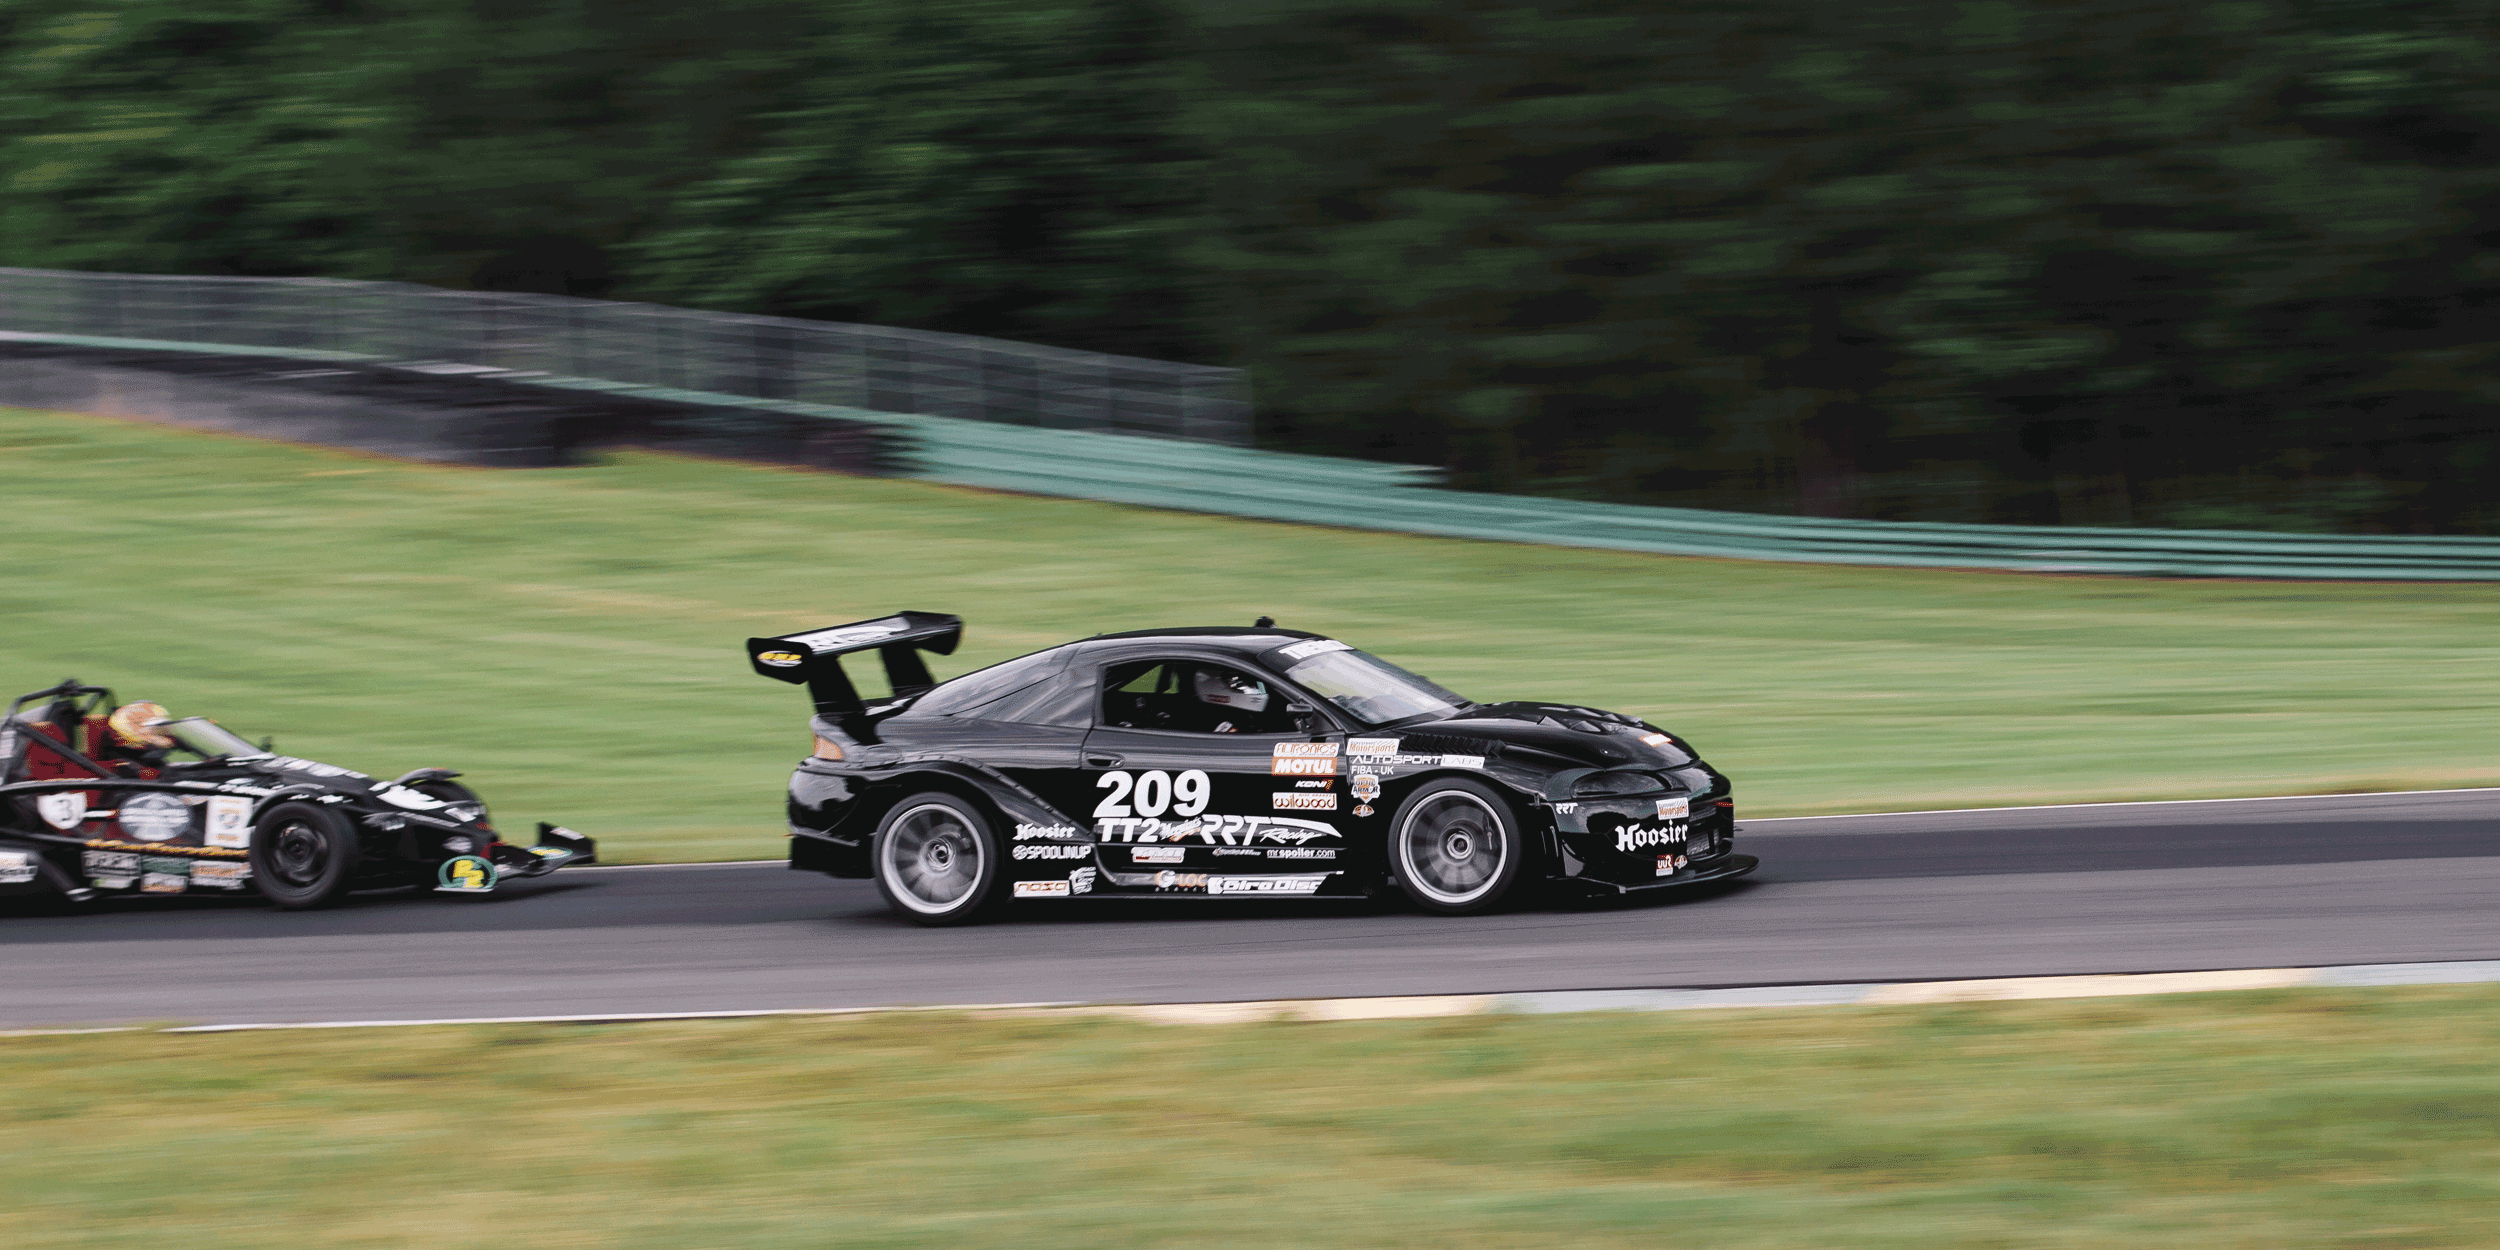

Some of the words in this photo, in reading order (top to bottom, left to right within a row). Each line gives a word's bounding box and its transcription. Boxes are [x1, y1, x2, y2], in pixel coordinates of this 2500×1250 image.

[1274, 758, 1334, 773] MOTUL
[1351, 754, 1442, 765] AUTOSPORT
[1351, 766, 1372, 775] FIBA
[1380, 766, 1394, 775] UK
[1295, 780, 1327, 788] KONI
[1092, 769, 1211, 818] 209
[1275, 794, 1335, 808] wilwood
[1555, 803, 1578, 814] RRT
[1012, 822, 1076, 841] Hoosier
[1098, 818, 1161, 842] TT2
[1200, 813, 1272, 846] RRT
[1258, 827, 1324, 845] Racing
[1614, 819, 1688, 852] Hoosier
[1026, 845, 1092, 860] SPOOLINUP
